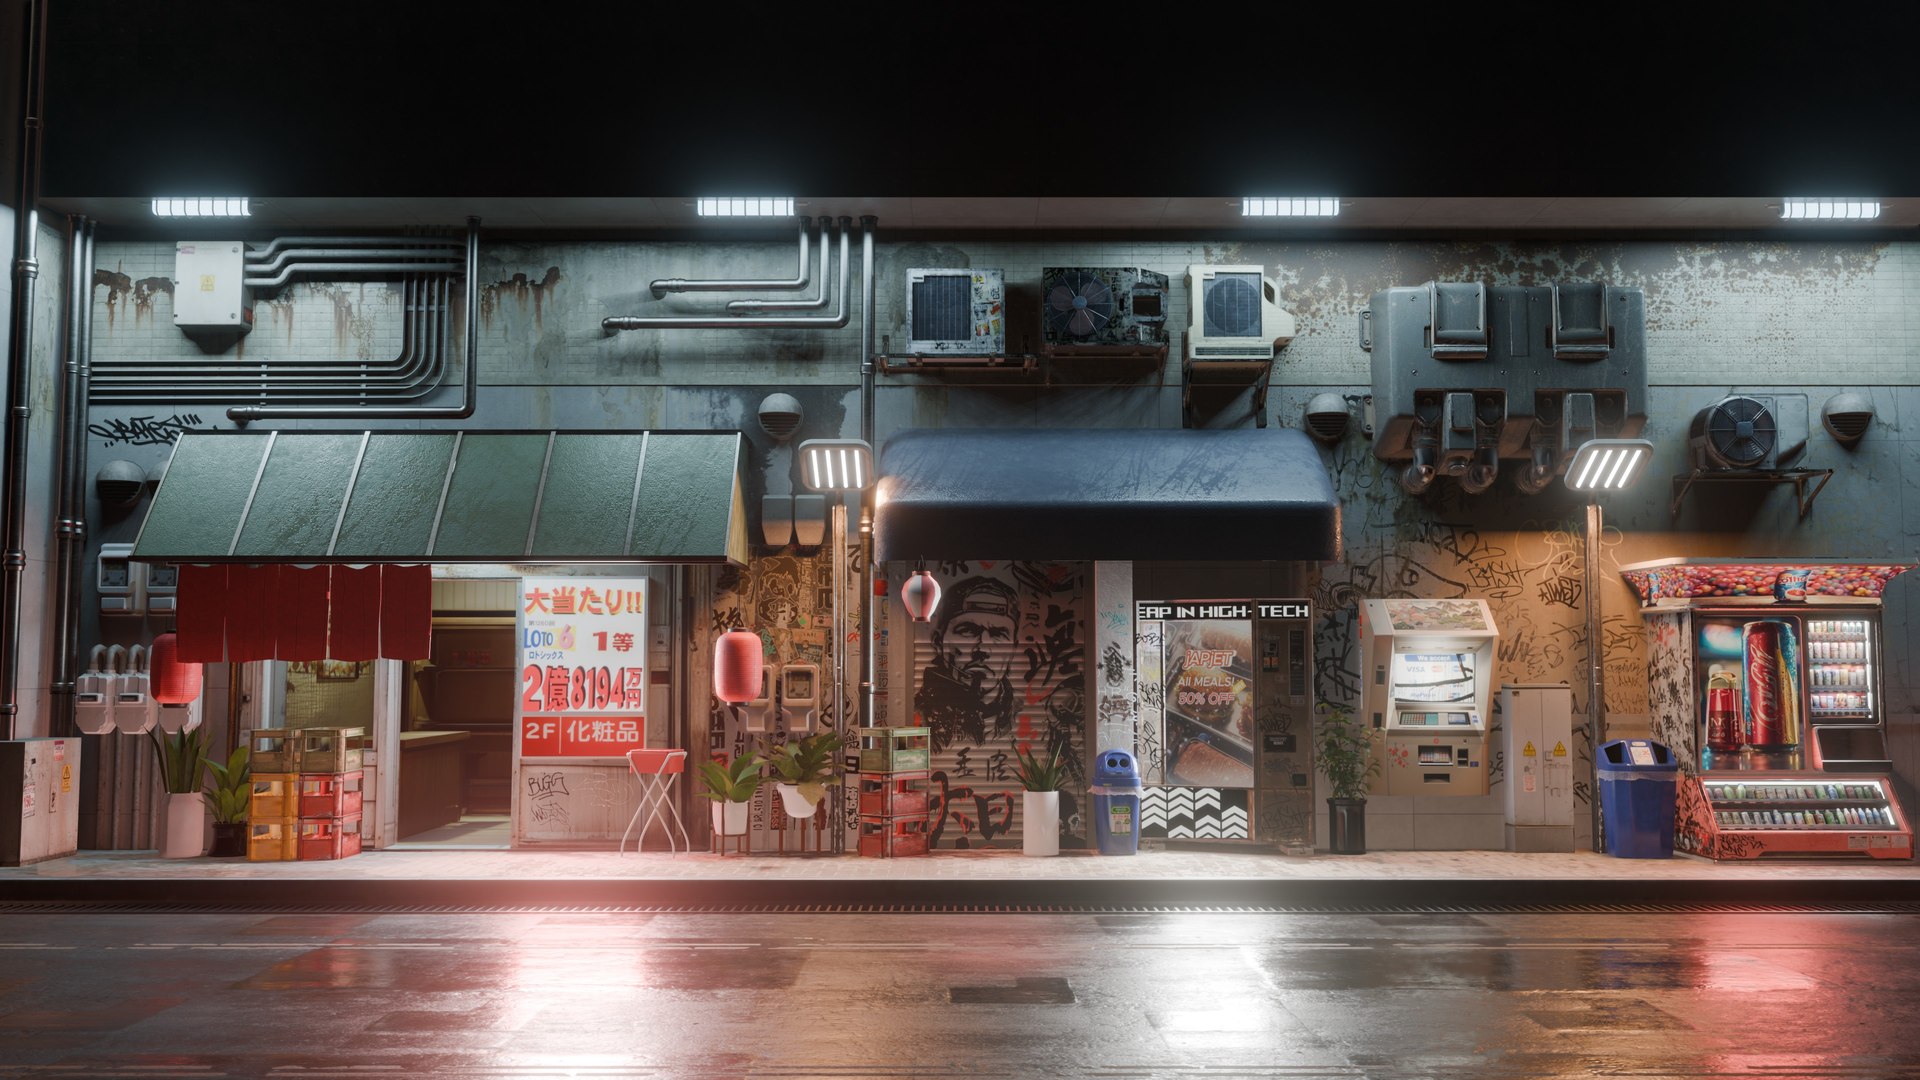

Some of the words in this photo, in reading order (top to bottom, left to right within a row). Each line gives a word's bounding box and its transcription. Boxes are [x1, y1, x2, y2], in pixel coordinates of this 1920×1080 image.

[525, 586, 642, 615] 大当たり!!
[1176, 606, 1195, 618] IN
[1258, 605, 1308, 617] TECH
[524, 628, 553, 648] LOTO
[559, 624, 574, 649] 6
[528, 651, 564, 660] ロトシックス
[1193, 677, 1235, 687] MEALS!
[1178, 691, 1206, 706] 50%
[1208, 691, 1236, 706] OFF
[526, 722, 556, 739] 2F
[567, 720, 639, 742] 化粧品
